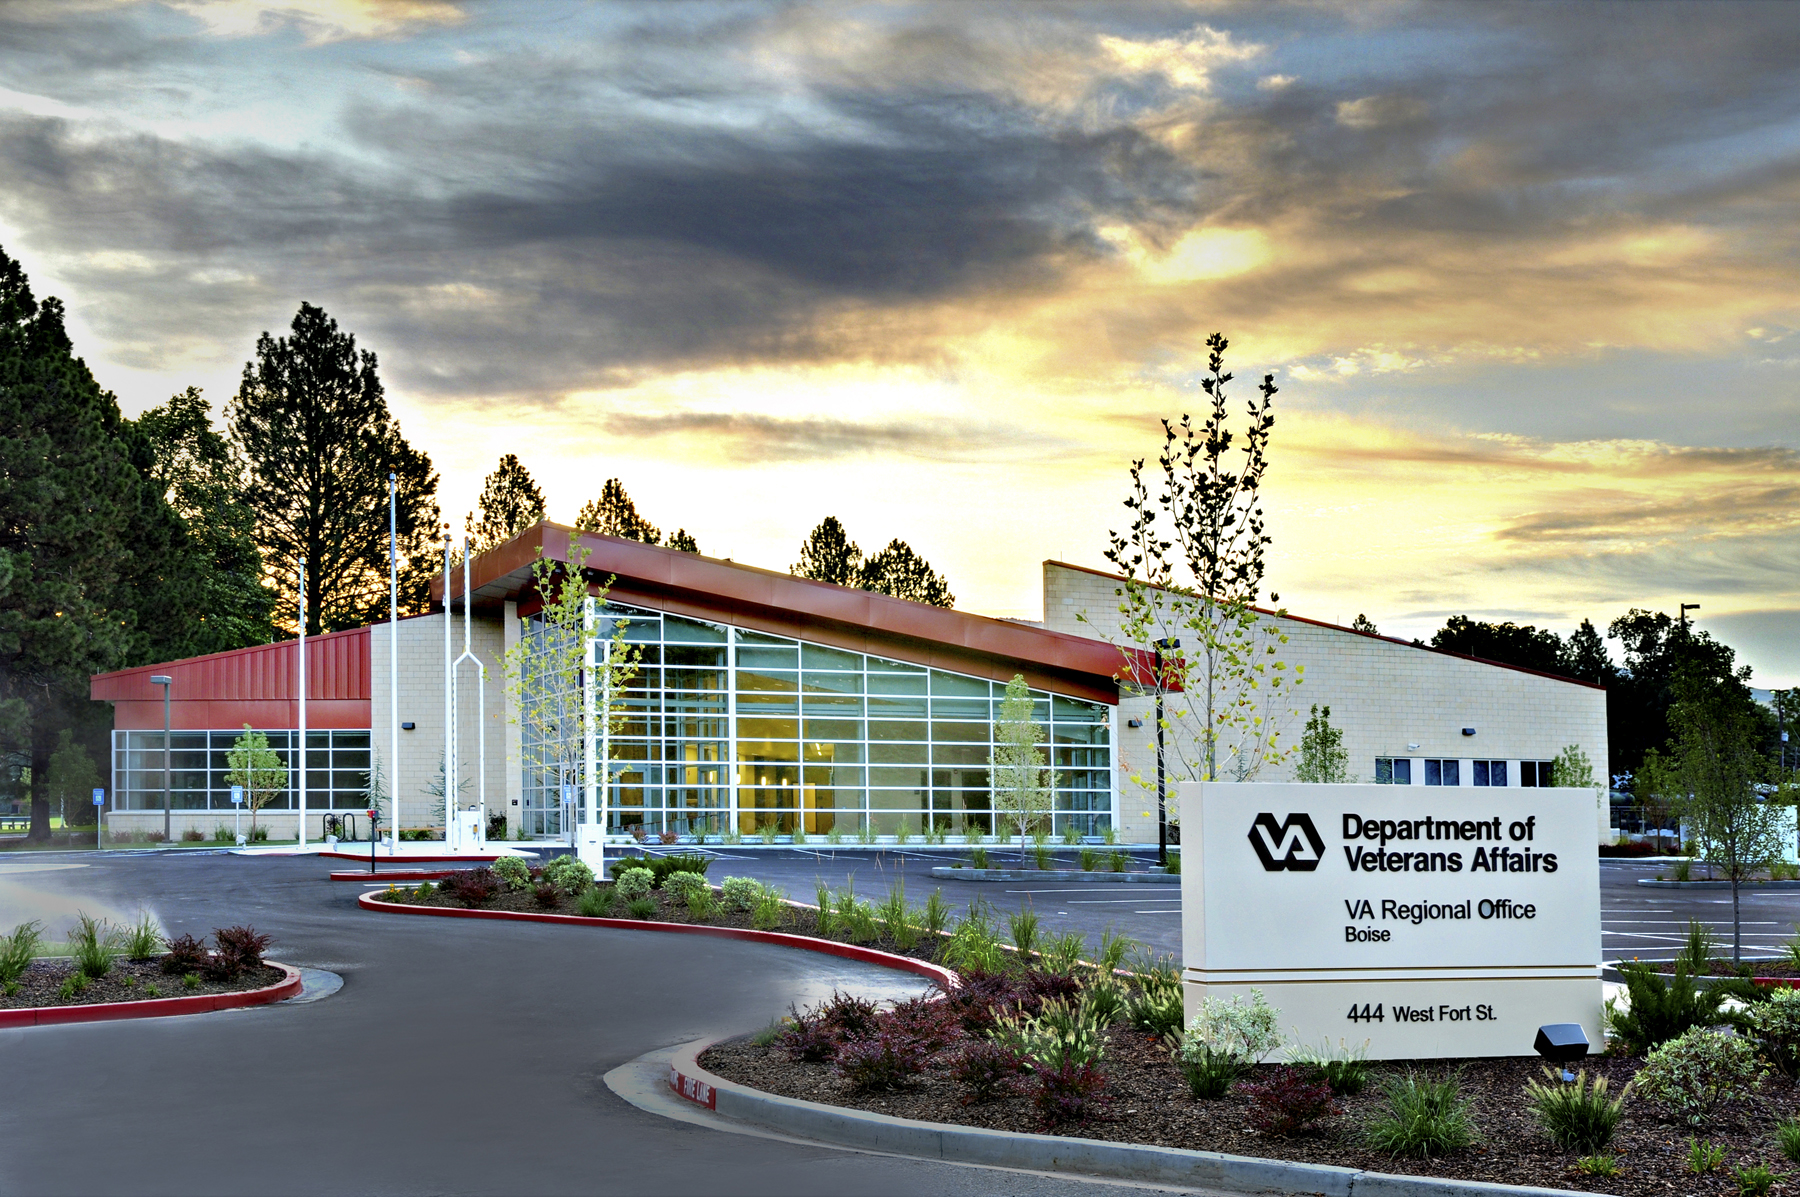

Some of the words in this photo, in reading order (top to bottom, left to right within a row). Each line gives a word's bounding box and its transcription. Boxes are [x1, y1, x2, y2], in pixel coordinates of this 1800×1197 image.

[1250, 817, 1322, 867] VA
[1342, 814, 1502, 846] Department
[1508, 815, 1536, 842] of
[1344, 846, 1463, 873] Veterans
[1471, 846, 1559, 874] Affairs
[1345, 899, 1375, 920] VA
[1381, 899, 1471, 925] Regional
[1478, 898, 1537, 920] Office
[1345, 926, 1391, 943] Boise
[1346, 1003, 1385, 1024] 444
[1392, 1006, 1435, 1023] West
[1439, 1005, 1471, 1022] Fort
[1476, 1004, 1498, 1022] St.
[683, 1076, 696, 1098] FIRE
[696, 1081, 710, 1103] LANE
